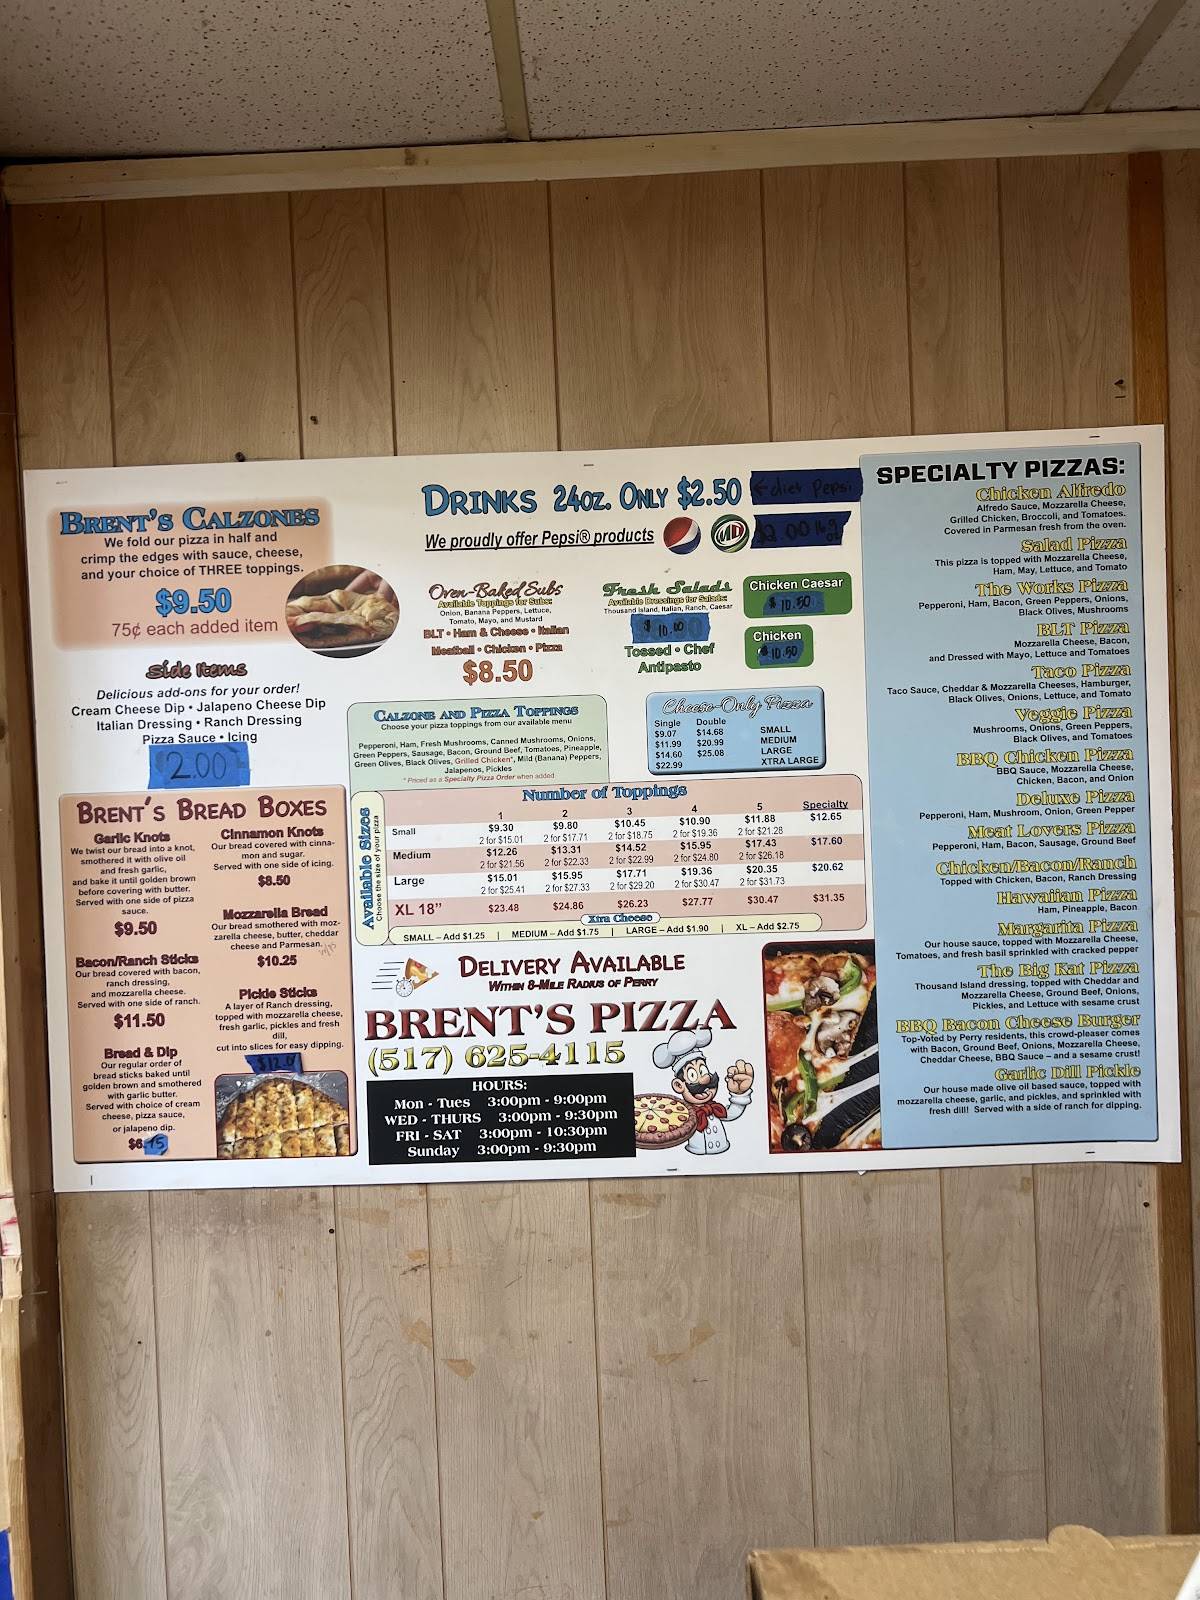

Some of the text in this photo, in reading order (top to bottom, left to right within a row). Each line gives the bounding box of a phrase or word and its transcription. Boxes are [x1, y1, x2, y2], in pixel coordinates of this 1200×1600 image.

[877, 457, 1125, 484] SPECIALTY PIZZAS:
[676, 475, 742, 510] $2.50
[975, 481, 1126, 501] Chicken Alfredo
[943, 525, 980, 534] Covered
[982, 525, 990, 533] in
[1038, 522, 1061, 530] fresh
[1063, 522, 1083, 530] from
[1086, 521, 1099, 529] the
[425, 534, 446, 548] We
[450, 532, 502, 550] proudly
[506, 531, 538, 546] offer
[594, 528, 654, 545] products
[1020, 535, 1127, 553] Salad Pizza
[524, 580, 563, 596] Subs
[602, 580, 733, 597] Fresh Salads
[748, 577, 844, 591] Chicken Caesar
[974, 577, 1128, 597] The Works Pizza
[155, 587, 231, 617] $9.50
[146, 620, 184, 635] each
[190, 618, 239, 634] added
[245, 618, 277, 632] item
[752, 630, 803, 644] Chicken
[623, 642, 715, 657] Tossed Chef
[195, 661, 247, 678] Items
[462, 658, 533, 686] $8.50
[637, 659, 701, 675] Antipasto
[71, 697, 325, 716] Cream Cheese Dip Jalapeno Cheese Dip
[764, 694, 813, 710] Pizza
[654, 719, 680, 728] Single
[696, 717, 726, 725] Double
[654, 729, 676, 738] $9.07
[760, 725, 791, 733] SMALL
[760, 735, 796, 744] MEDIUM
[761, 756, 819, 765] XTRA LARGE
[521, 783, 687, 801] Number of Toppings
[1015, 788, 1135, 806] Deluxe Pizza
[562, 809, 567, 817] 2
[626, 807, 632, 815] 3
[691, 804, 697, 812] 4
[757, 802, 762, 810] 5
[803, 800, 849, 811] Specialty
[498, 811, 502, 819] 1
[392, 811, 841, 835] Small $9.30 $9.80 $10.45 $10.90 $11.88 $12.65
[967, 820, 1136, 839] Meat Lovers Pizza
[220, 825, 324, 839] Cinnamon Knots
[479, 834, 522, 844] 2 for $15.01
[393, 851, 430, 859] Medium
[213, 862, 242, 870] Served
[244, 861, 261, 869] with
[281, 860, 298, 868] side
[300, 859, 309, 867] of
[311, 859, 333, 868] icing.
[746, 864, 777, 874] $20.35
[935, 854, 1137, 875] Chicken/Bacon/Ranch
[257, 874, 290, 887] $8.50
[394, 876, 424, 887] Large
[939, 871, 1136, 886] Topped with Chicken, Bacon, Ranch Dressing
[996, 886, 1137, 904] Hawaiian Pizza
[395, 903, 414, 915] XL
[1037, 903, 1137, 914] Ham, Pineapple, Bacon
[114, 920, 157, 937] $9.50
[257, 954, 297, 967] $10.25
[113, 1012, 165, 1029] $11.50
[589, 998, 737, 1033] PIZZA
[367, 1039, 625, 1076] (517) 625-4115
[994, 1063, 1141, 1081] Garlic Dill Pickle
[472, 1079, 526, 1091] HOURS:
[394, 1099, 423, 1109] Mon
[436, 1097, 470, 1108] Tues
[487, 1095, 540, 1108] 3:00pm
[553, 1093, 606, 1106] 9:00pm
[123, 1124, 157, 1134] jalapeno
[159, 1123, 175, 1132] dip.
[407, 1144, 459, 1158] Sunday
[477, 1143, 530, 1156] 3:00pm
[543, 1141, 596, 1154] 9:30pm
